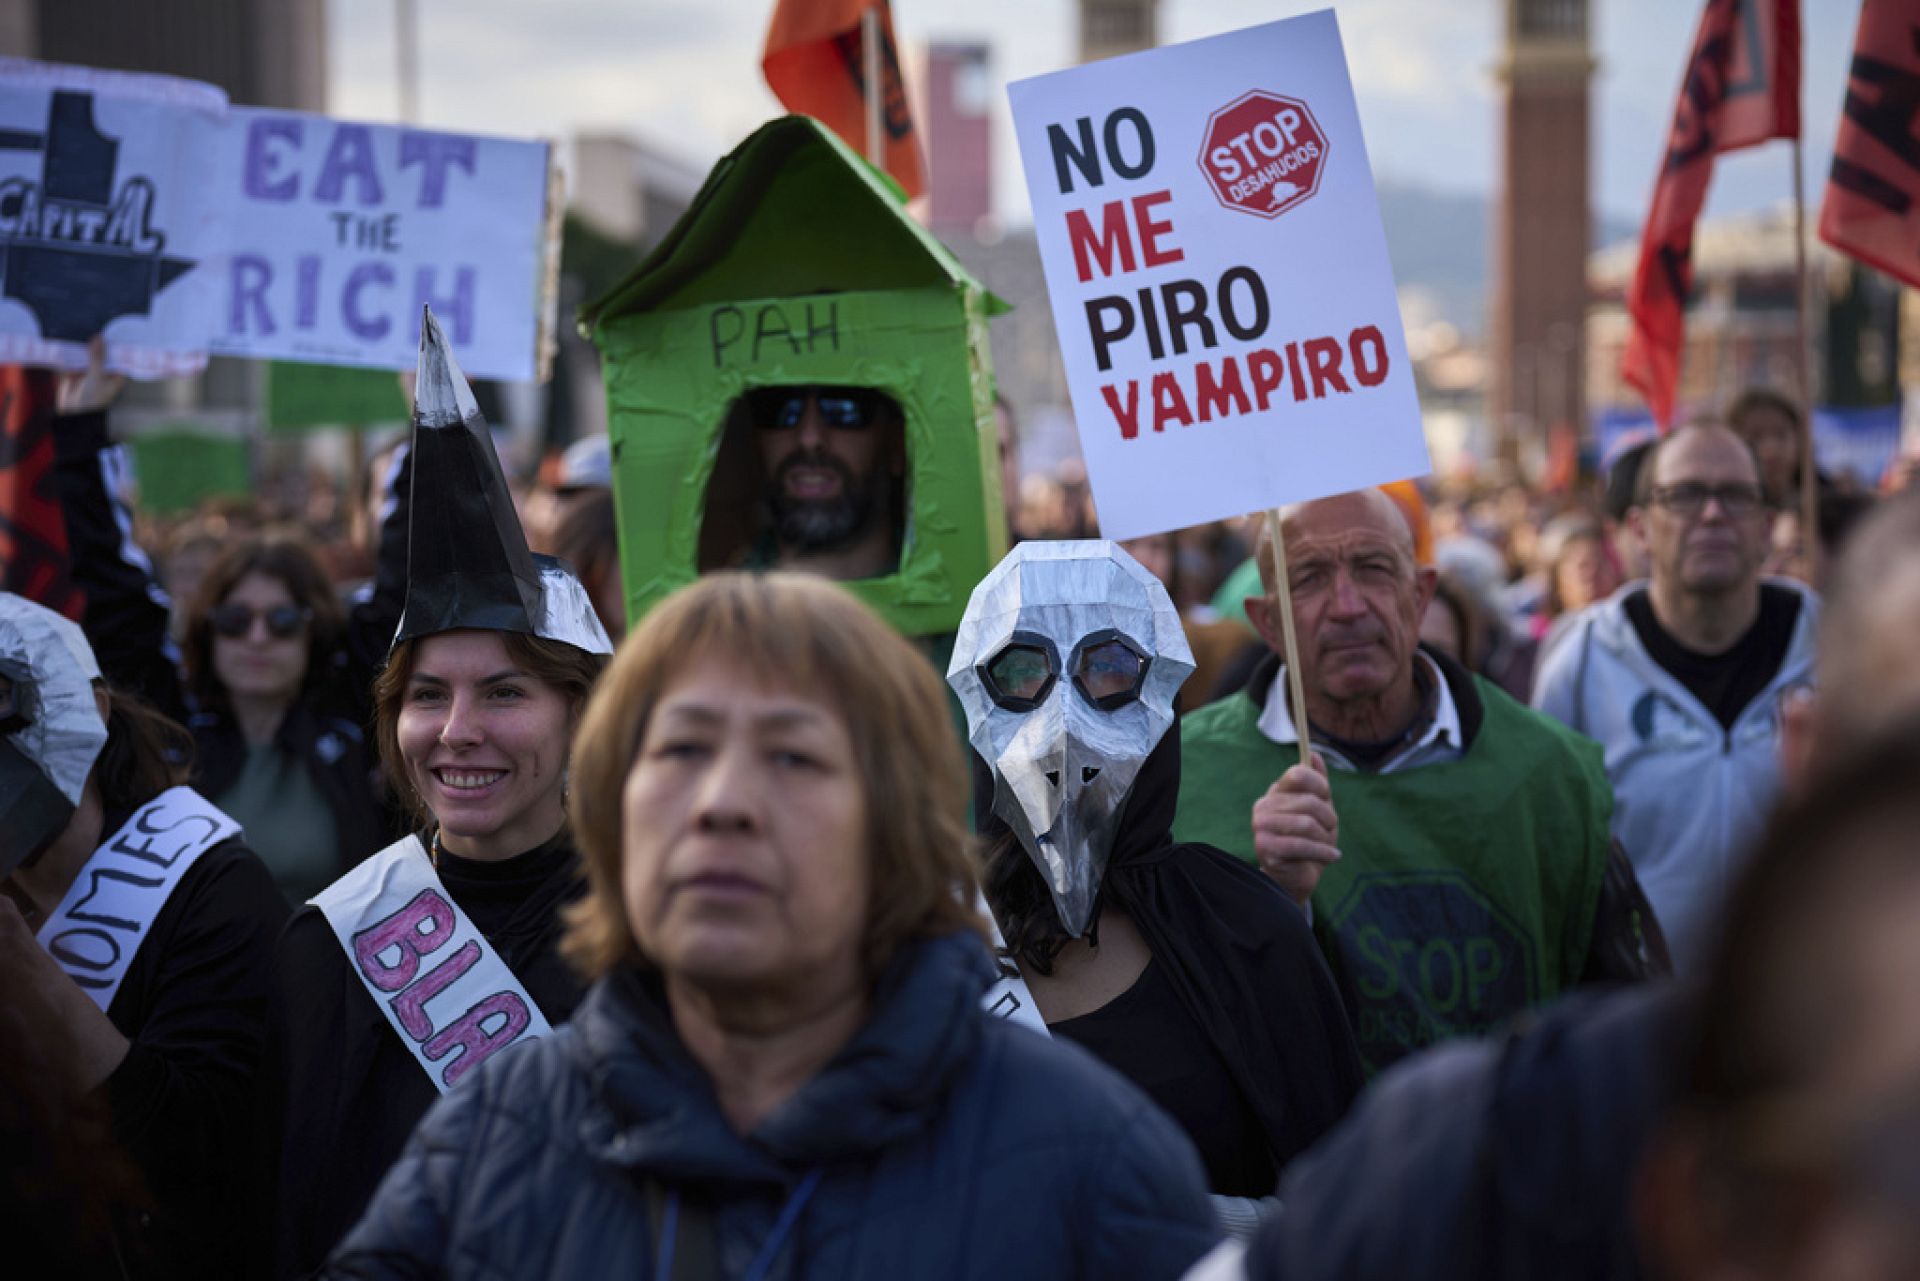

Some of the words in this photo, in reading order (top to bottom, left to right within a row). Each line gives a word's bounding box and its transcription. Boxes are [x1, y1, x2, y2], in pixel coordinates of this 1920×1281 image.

[243, 117, 476, 208] EAT
[1047, 106, 1156, 194] NO
[1211, 108, 1300, 181] STOP
[1228, 141, 1319, 202] DESAHUCIOS
[0, 174, 165, 253] CAPITAL
[329, 211, 402, 252] THE
[1065, 189, 1184, 283] ME
[228, 254, 477, 347] RICH
[709, 302, 840, 368] PAH
[1084, 265, 1271, 372] PIRO
[1100, 325, 1390, 440] VAMPIRO
[351, 887, 541, 1088] BLA
[1357, 925, 1504, 1013] STOP
